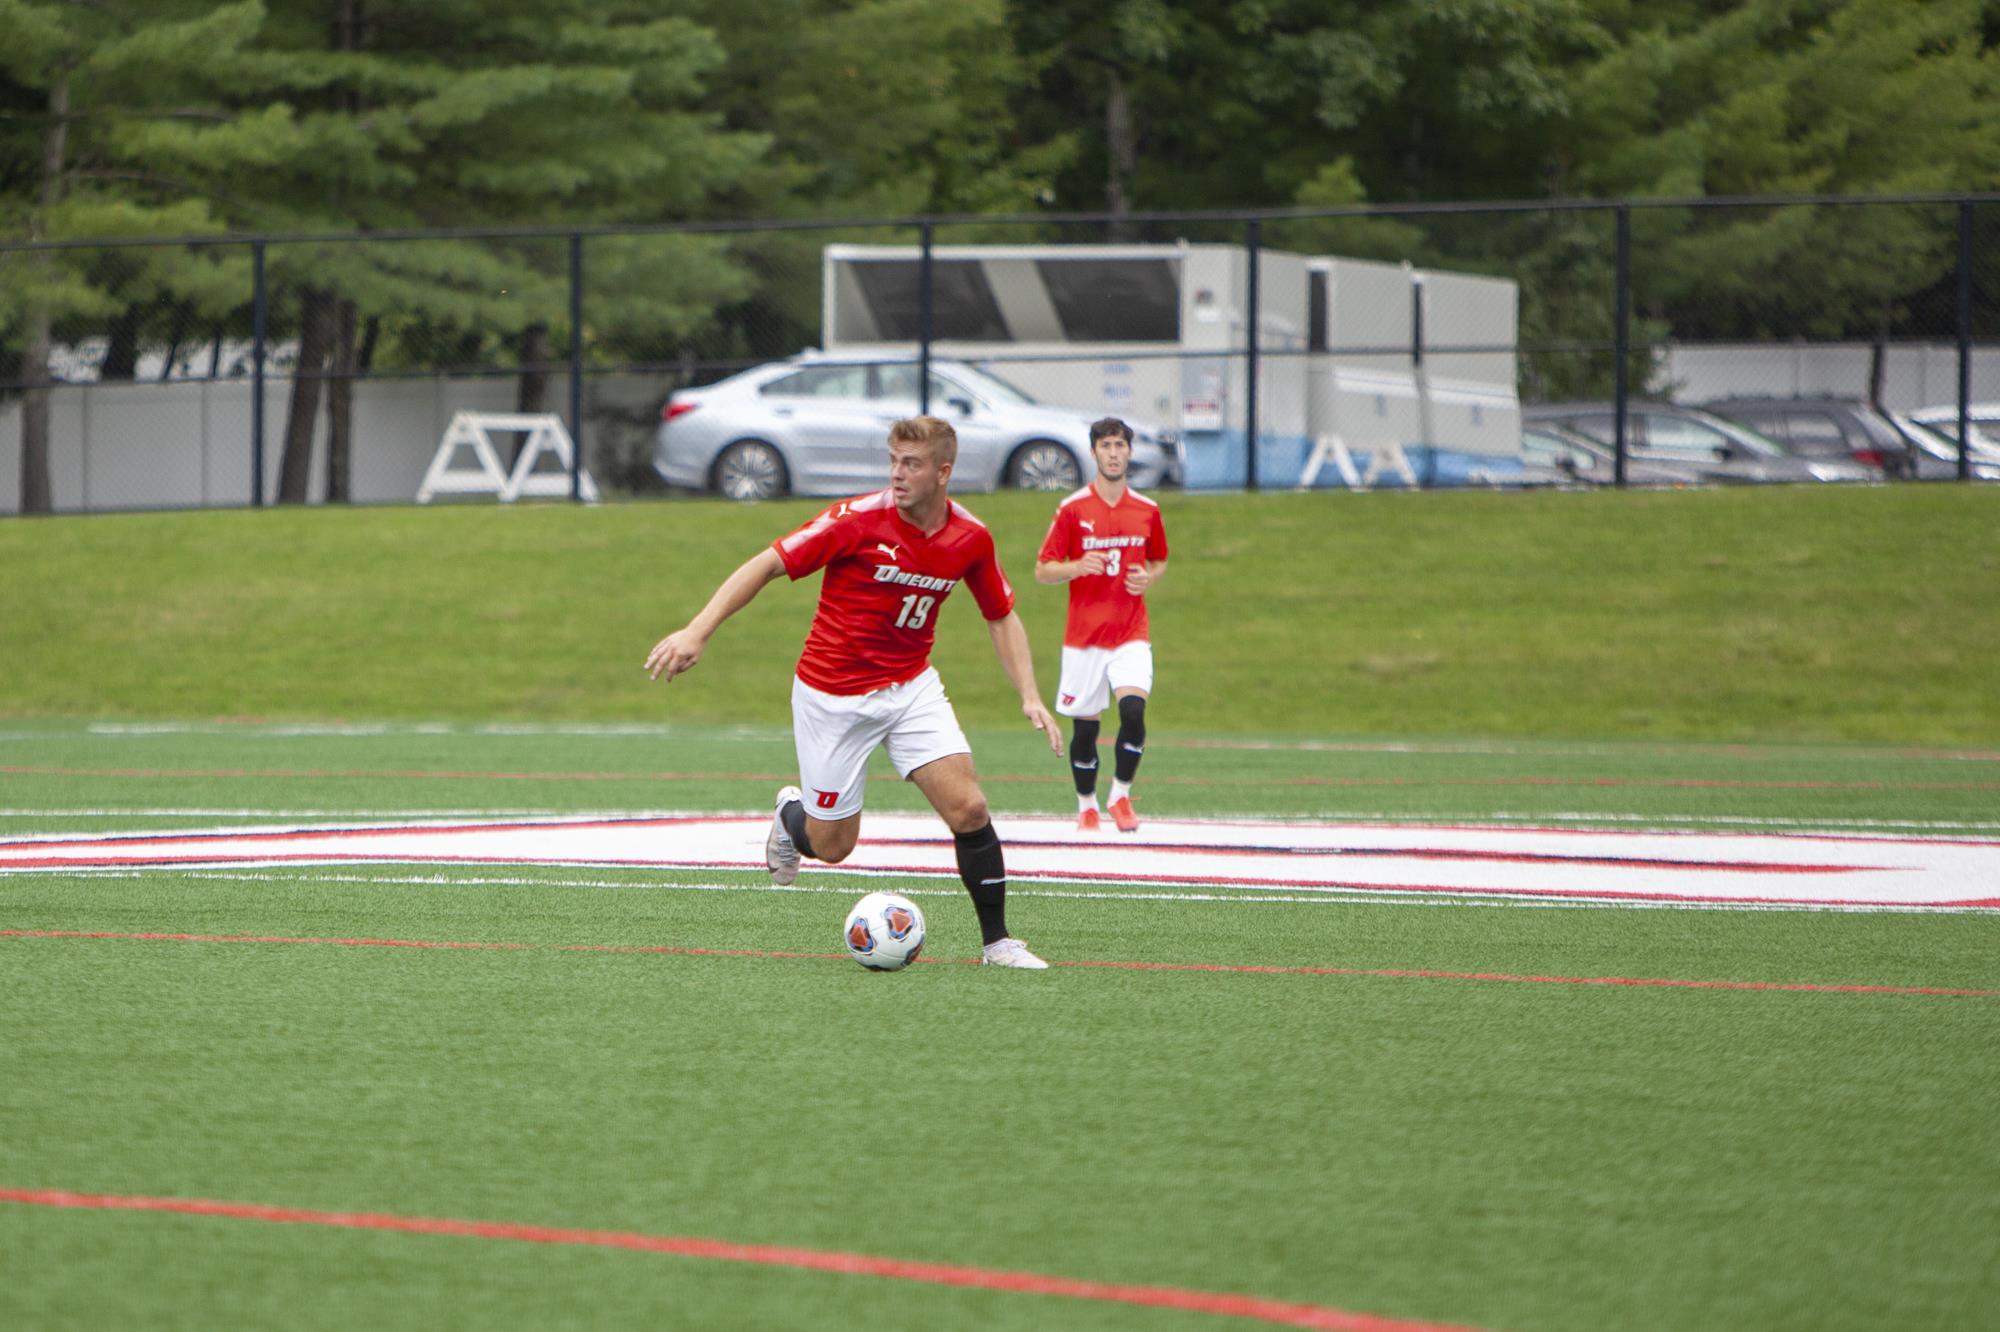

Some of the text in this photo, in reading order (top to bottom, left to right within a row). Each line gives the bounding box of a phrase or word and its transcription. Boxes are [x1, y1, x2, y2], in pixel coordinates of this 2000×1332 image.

[1106, 550, 1121, 576] 3
[873, 565, 957, 592] ONEONT
[895, 594, 935, 629] 19
